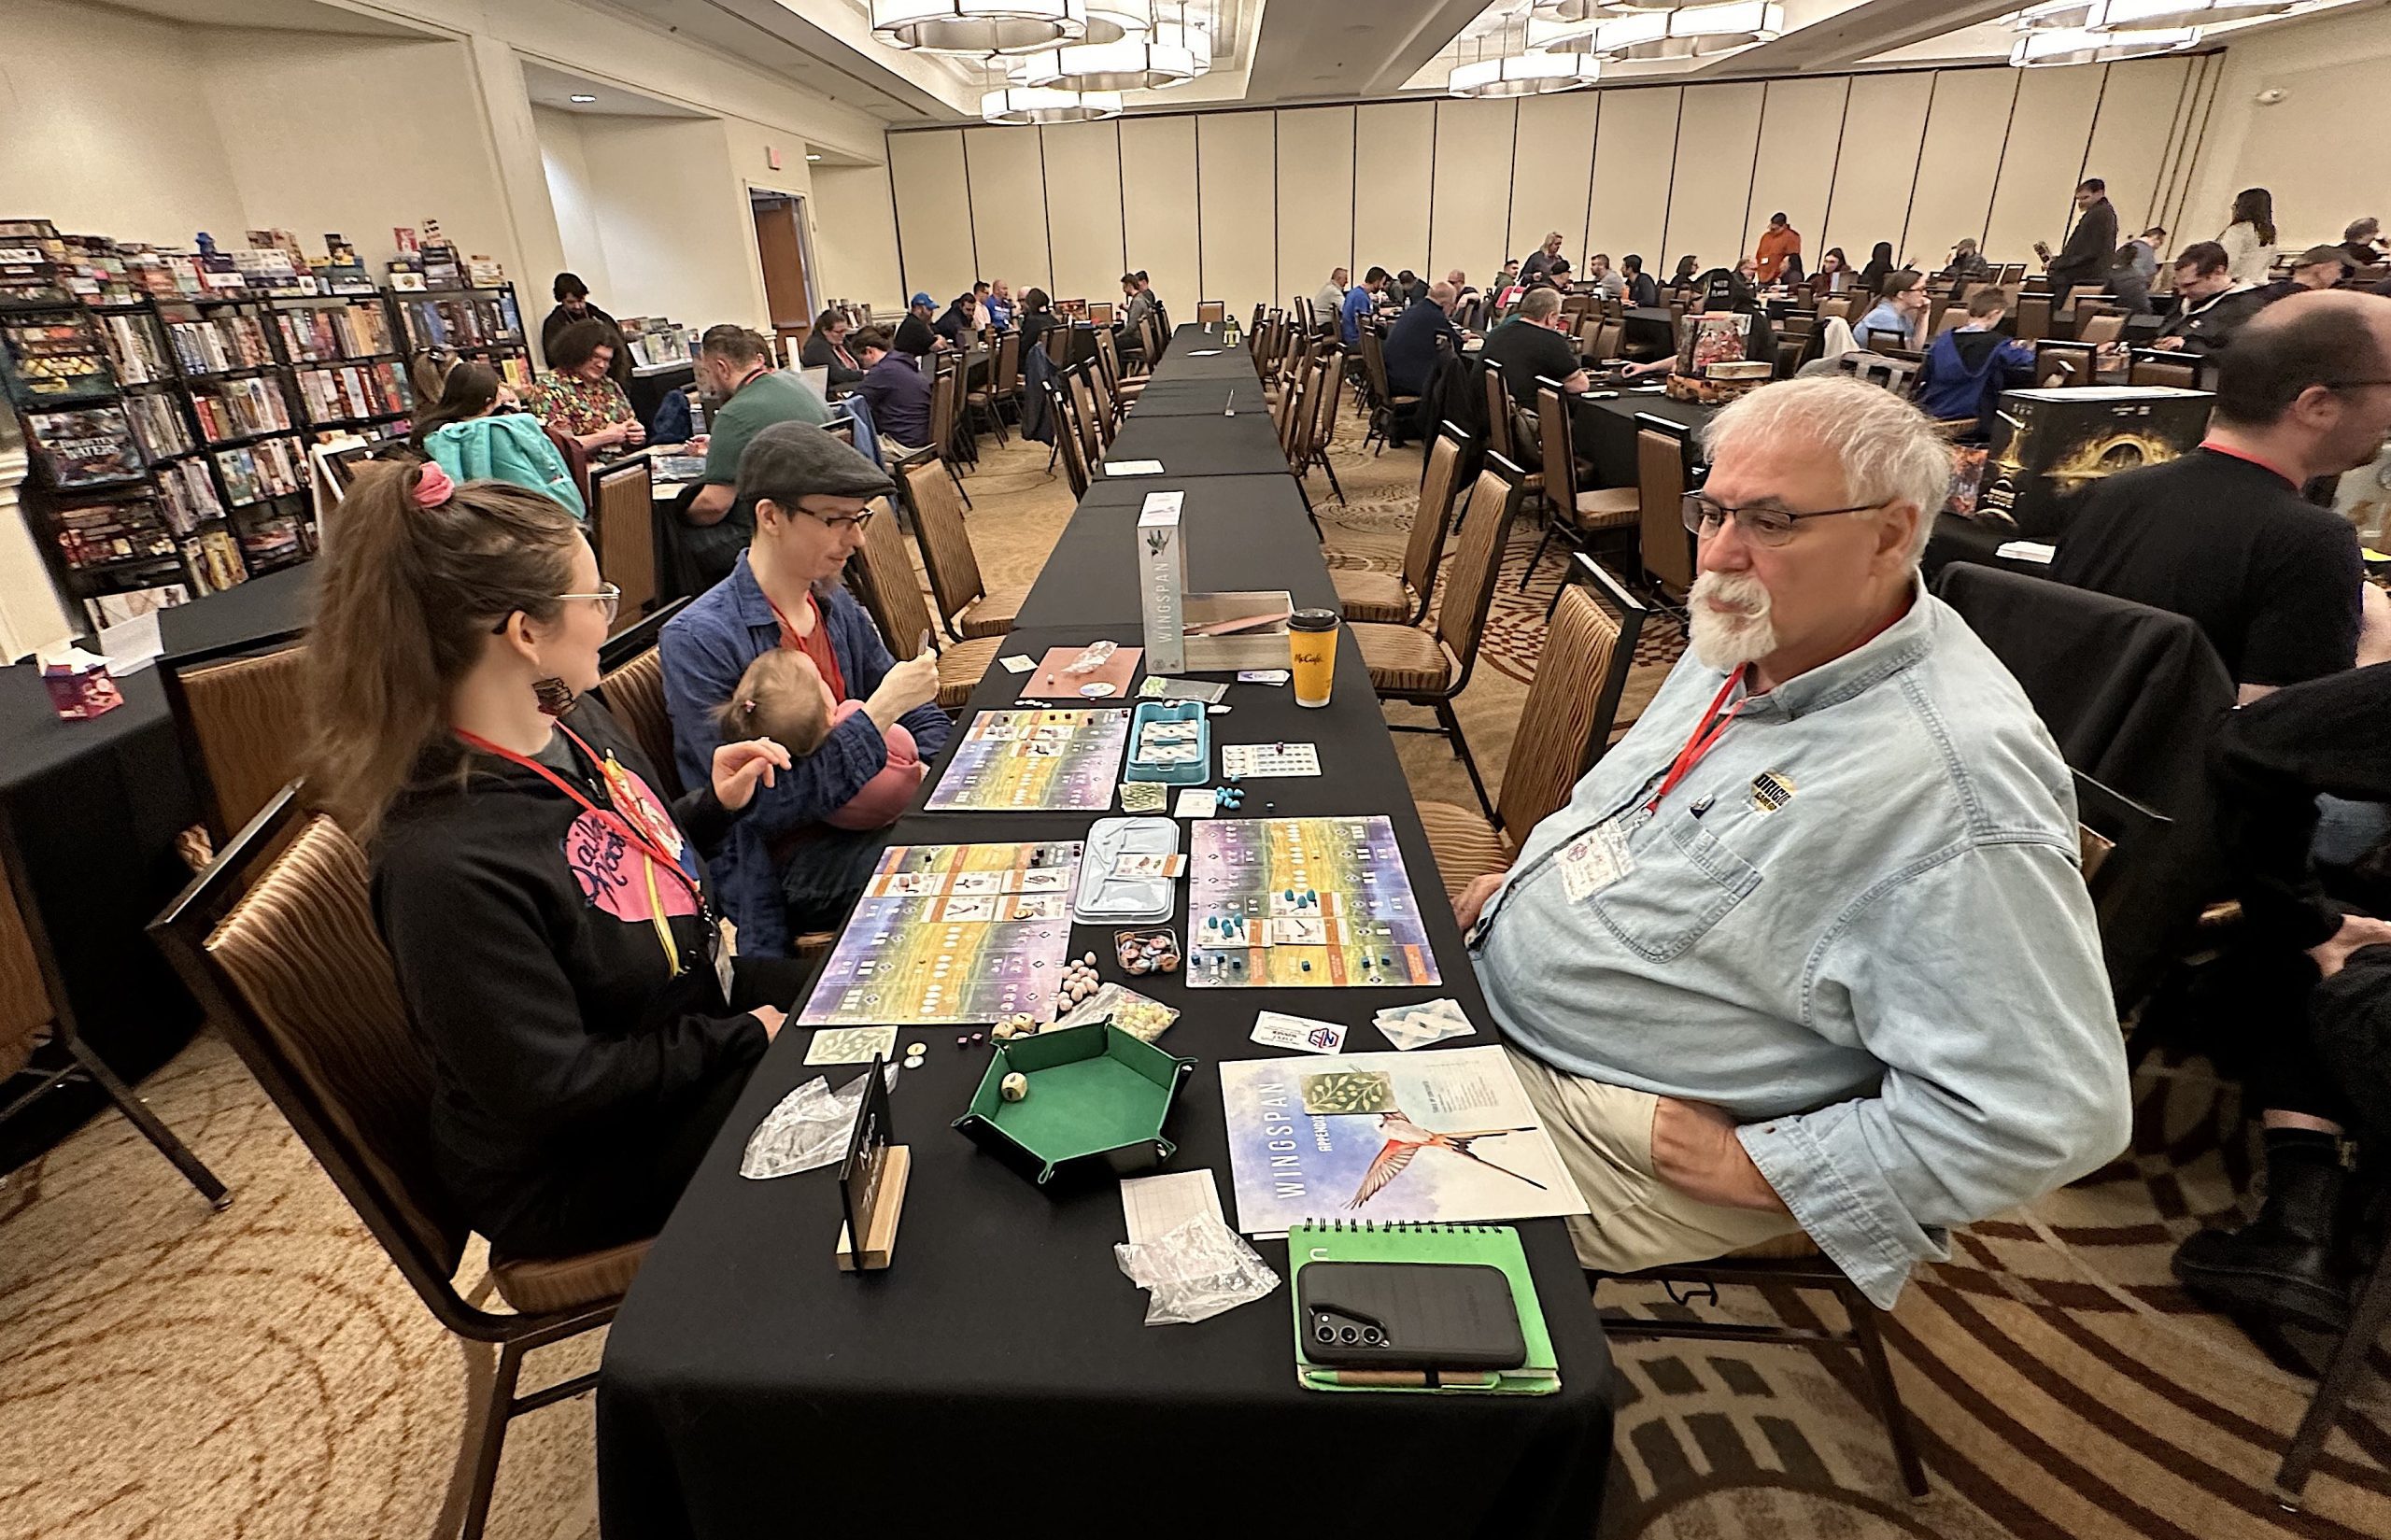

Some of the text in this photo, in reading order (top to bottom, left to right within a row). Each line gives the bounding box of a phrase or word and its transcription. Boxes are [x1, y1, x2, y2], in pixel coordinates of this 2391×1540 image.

[1153, 561, 1173, 643] WINGSPAN
[1258, 1082, 1307, 1199] WINGSPAN
[1310, 1115, 1333, 1152] APPENDIX
